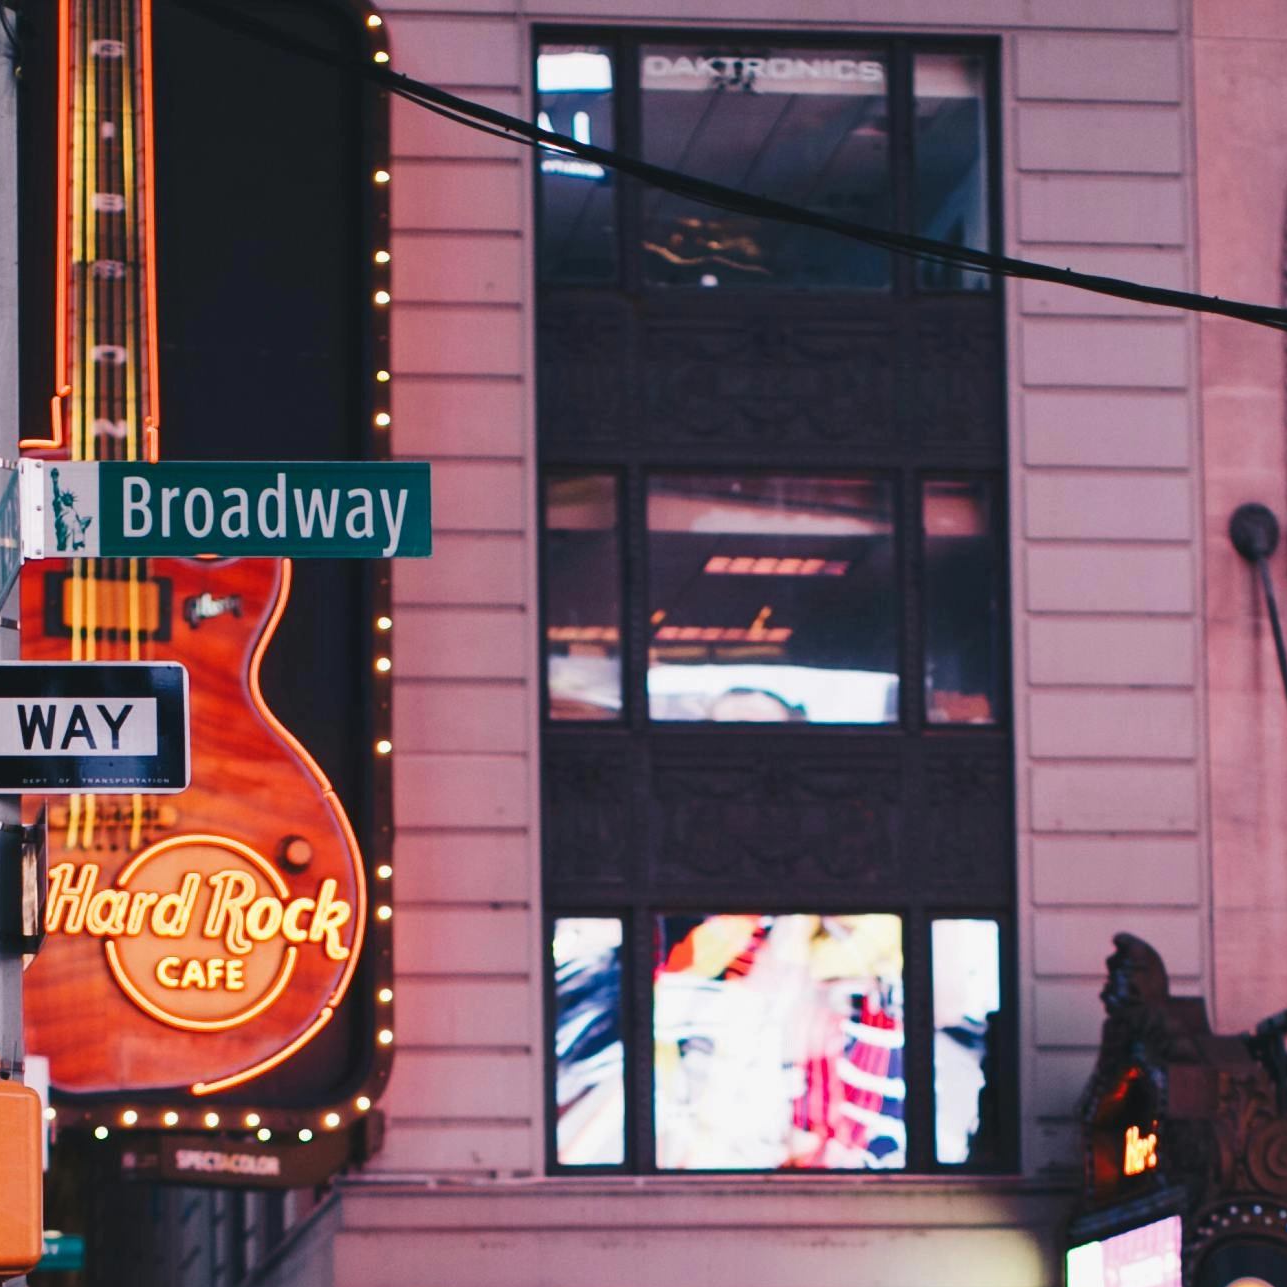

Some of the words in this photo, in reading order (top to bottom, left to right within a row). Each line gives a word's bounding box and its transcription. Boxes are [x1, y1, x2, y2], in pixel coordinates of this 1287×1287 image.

[644, 55, 884, 83] DAKTRONICS
[122, 473, 409, 557] Broadway
[17, 704, 133, 750] WAY
[45, 863, 201, 936] Hard
[204, 869, 351, 960] Rock
[155, 956, 245, 990] CAFE
